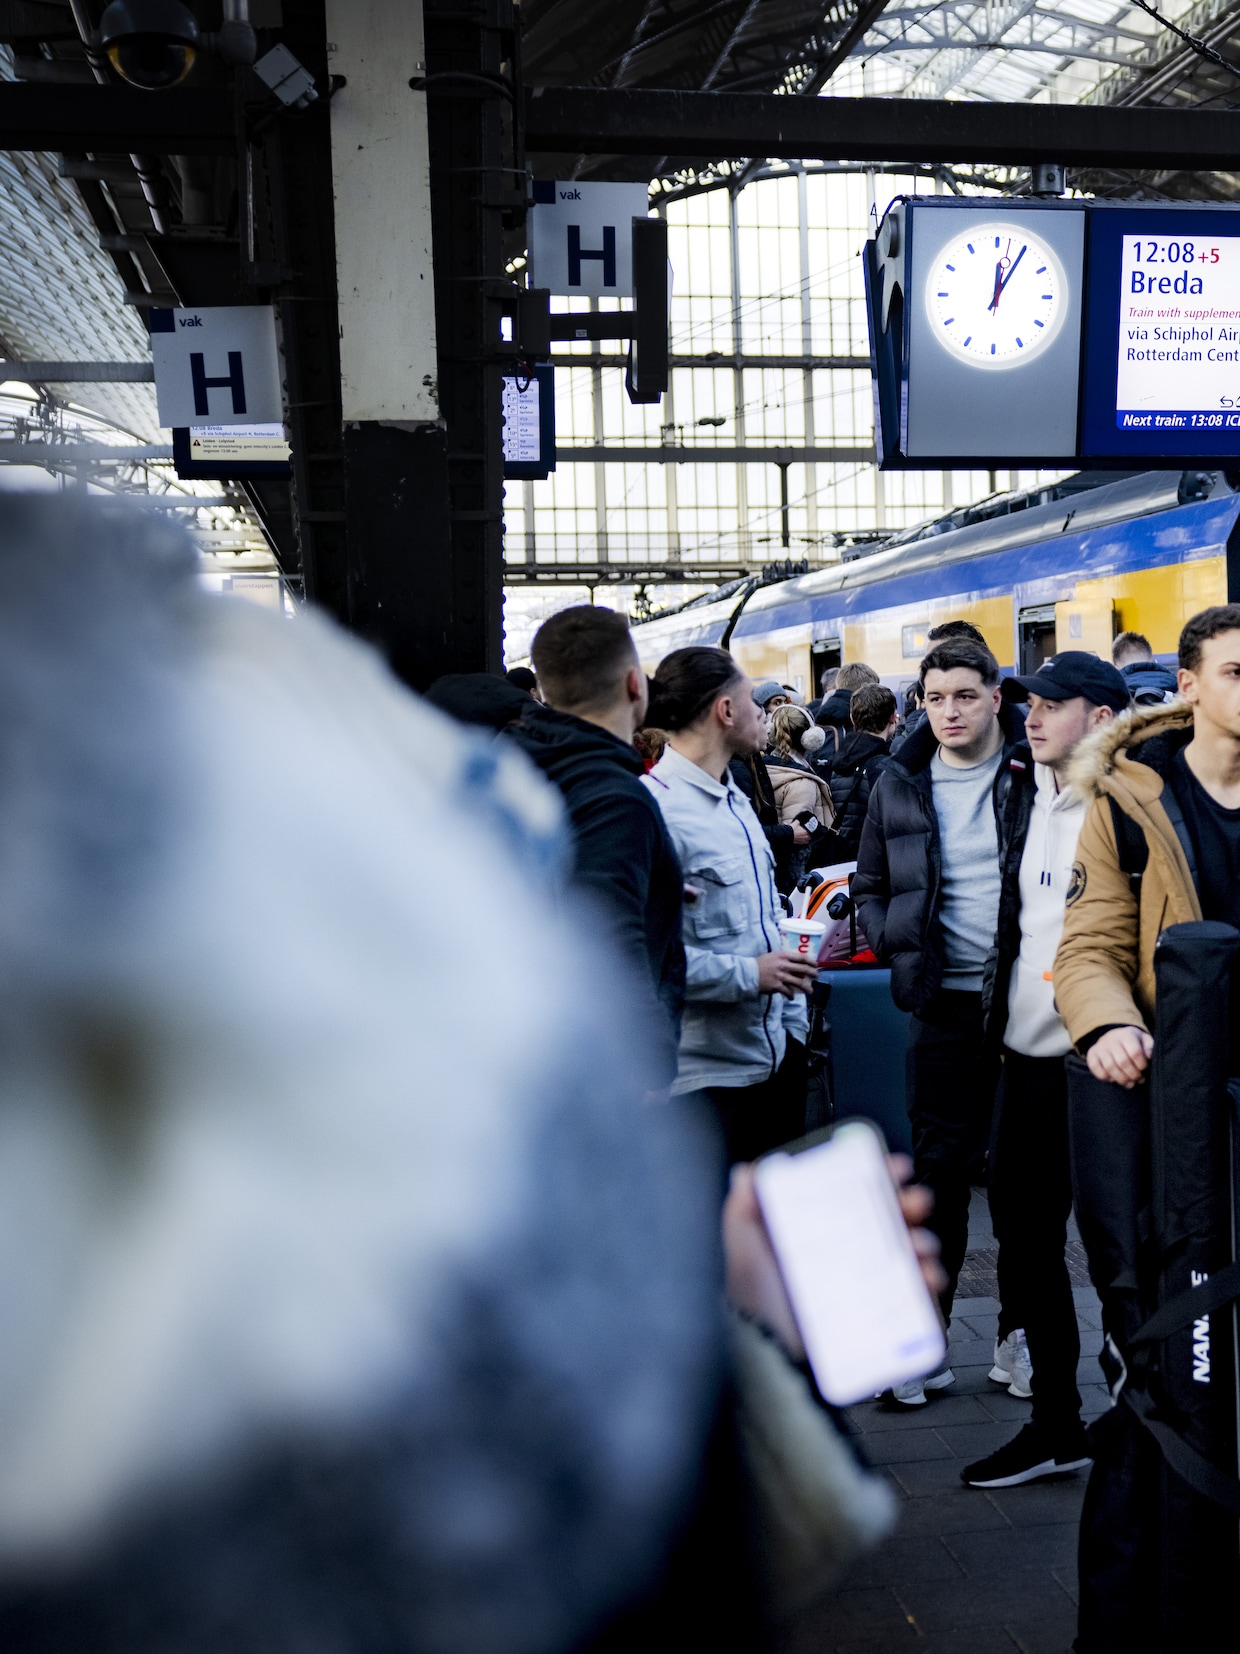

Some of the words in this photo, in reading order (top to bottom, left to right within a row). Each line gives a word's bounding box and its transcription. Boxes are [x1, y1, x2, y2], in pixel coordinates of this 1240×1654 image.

[560, 189, 581, 200] vak
[567, 225, 616, 287] H
[1133, 241, 1195, 263] 12:08
[1198, 248, 1220, 263] +5
[1131, 269, 1203, 295] Breda
[1129, 307, 1154, 318] Train
[1157, 307, 1181, 318] with
[178, 315, 203, 327] vak
[1127, 326, 1148, 341] via
[1153, 326, 1213, 344] Schiphol
[1127, 347, 1202, 362] Rotterdam
[190, 351, 247, 416] H
[1123, 414, 1152, 427] Next
[1155, 414, 1187, 427] train:
[1190, 414, 1223, 427] 13:08
